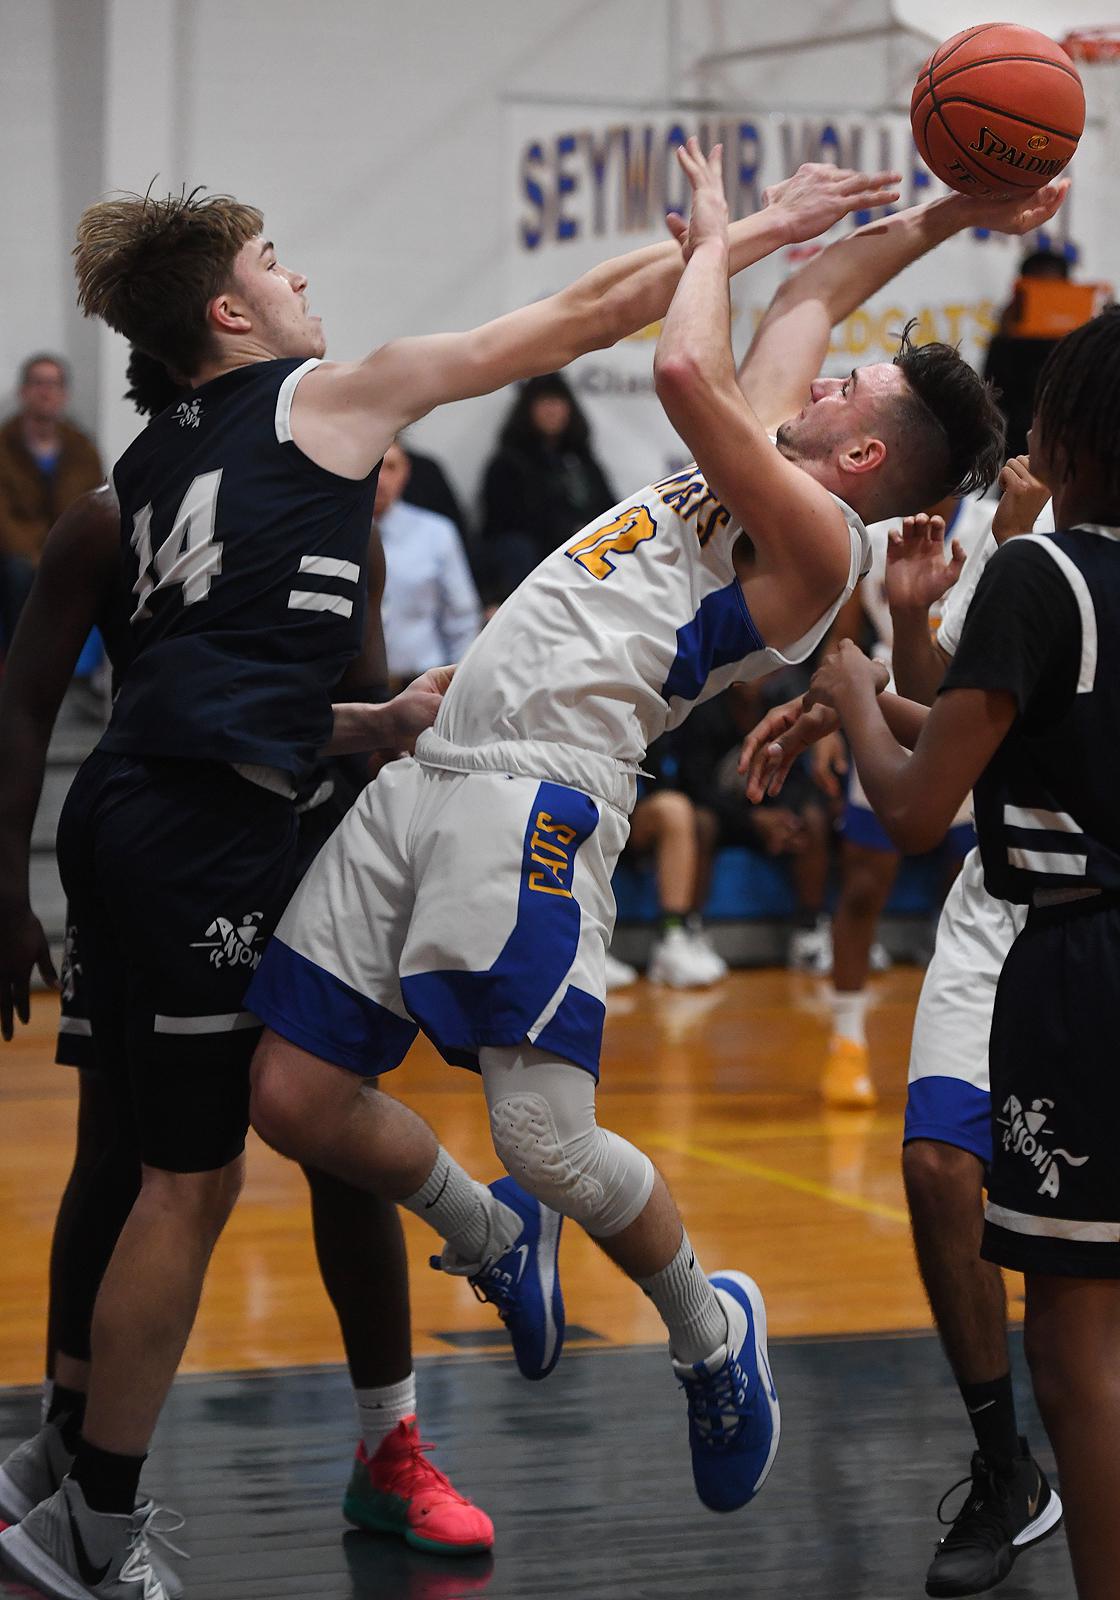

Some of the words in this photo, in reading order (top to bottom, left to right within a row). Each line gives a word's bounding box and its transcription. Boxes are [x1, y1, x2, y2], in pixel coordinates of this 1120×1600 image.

[968, 126, 1070, 177] SPALDIN
[130, 467, 224, 624] 14
[528, 811, 577, 899] CATS
